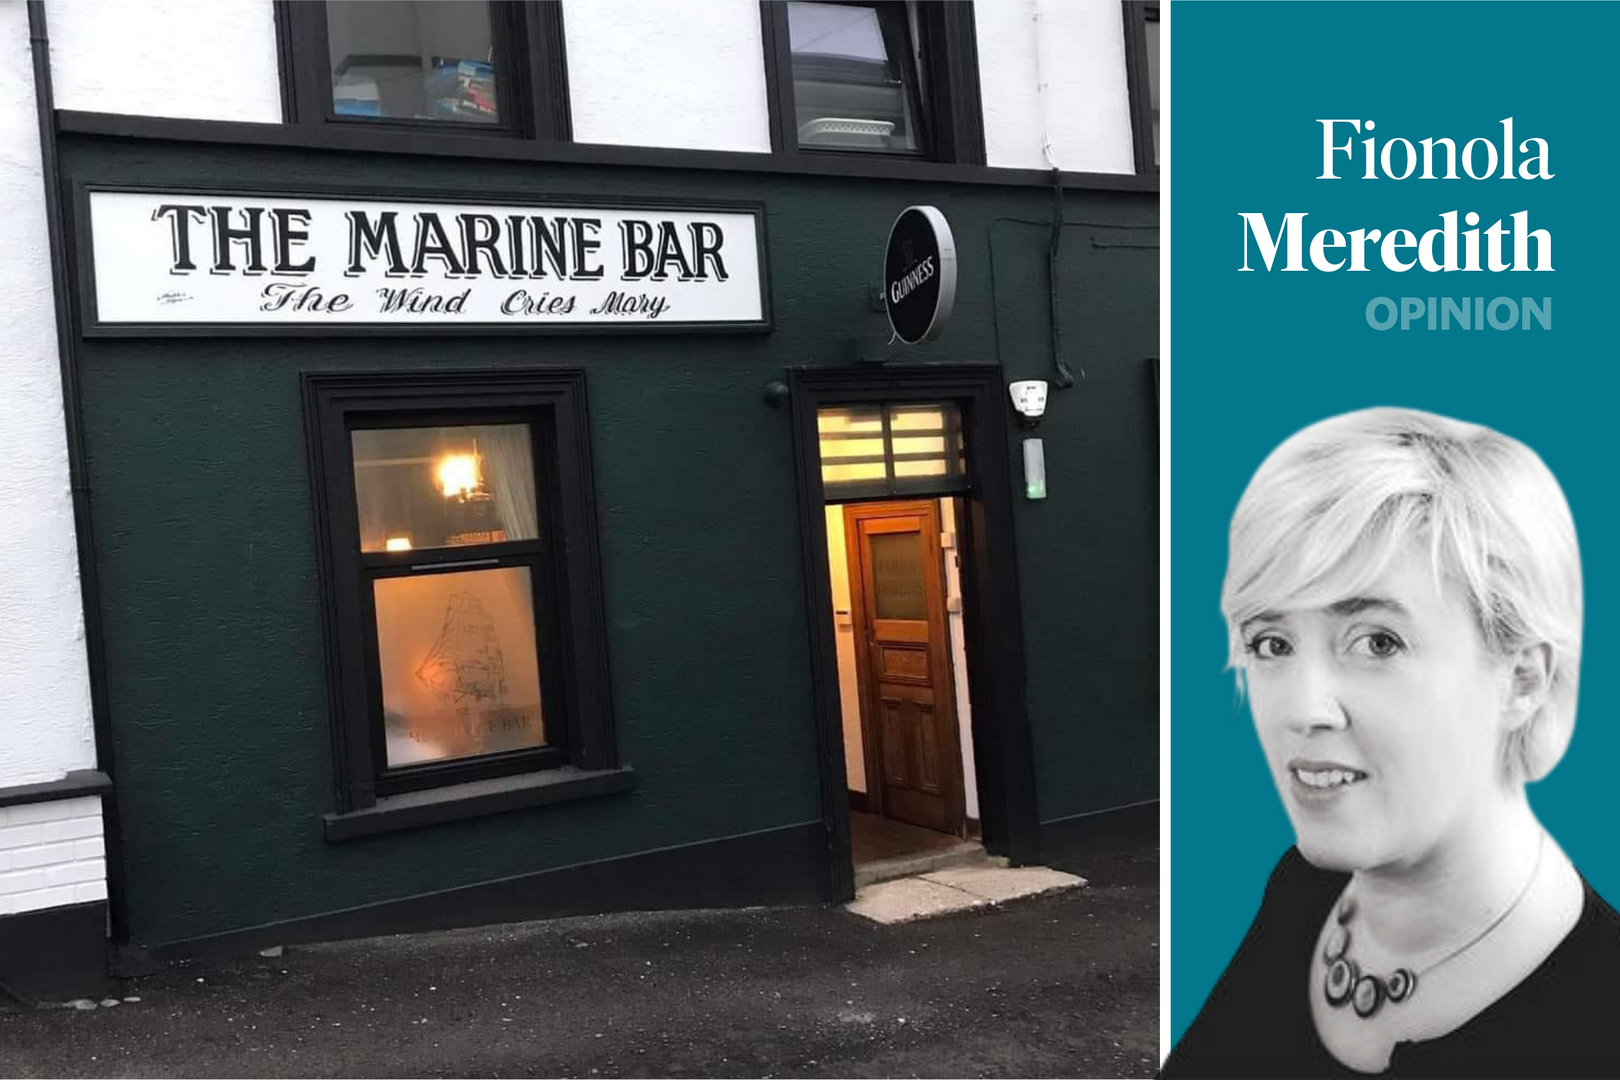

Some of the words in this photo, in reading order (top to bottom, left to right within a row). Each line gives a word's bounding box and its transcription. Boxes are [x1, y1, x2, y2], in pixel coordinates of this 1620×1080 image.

[152, 204, 316, 276] THE
[344, 211, 604, 281] MARINE
[618, 219, 728, 282] BAR
[260, 282, 353, 312] The
[376, 287, 471, 314] Wind
[500, 289, 577, 316] Cries
[590, 291, 670, 319] Mary
[891, 256, 934, 304] GUINNESS
